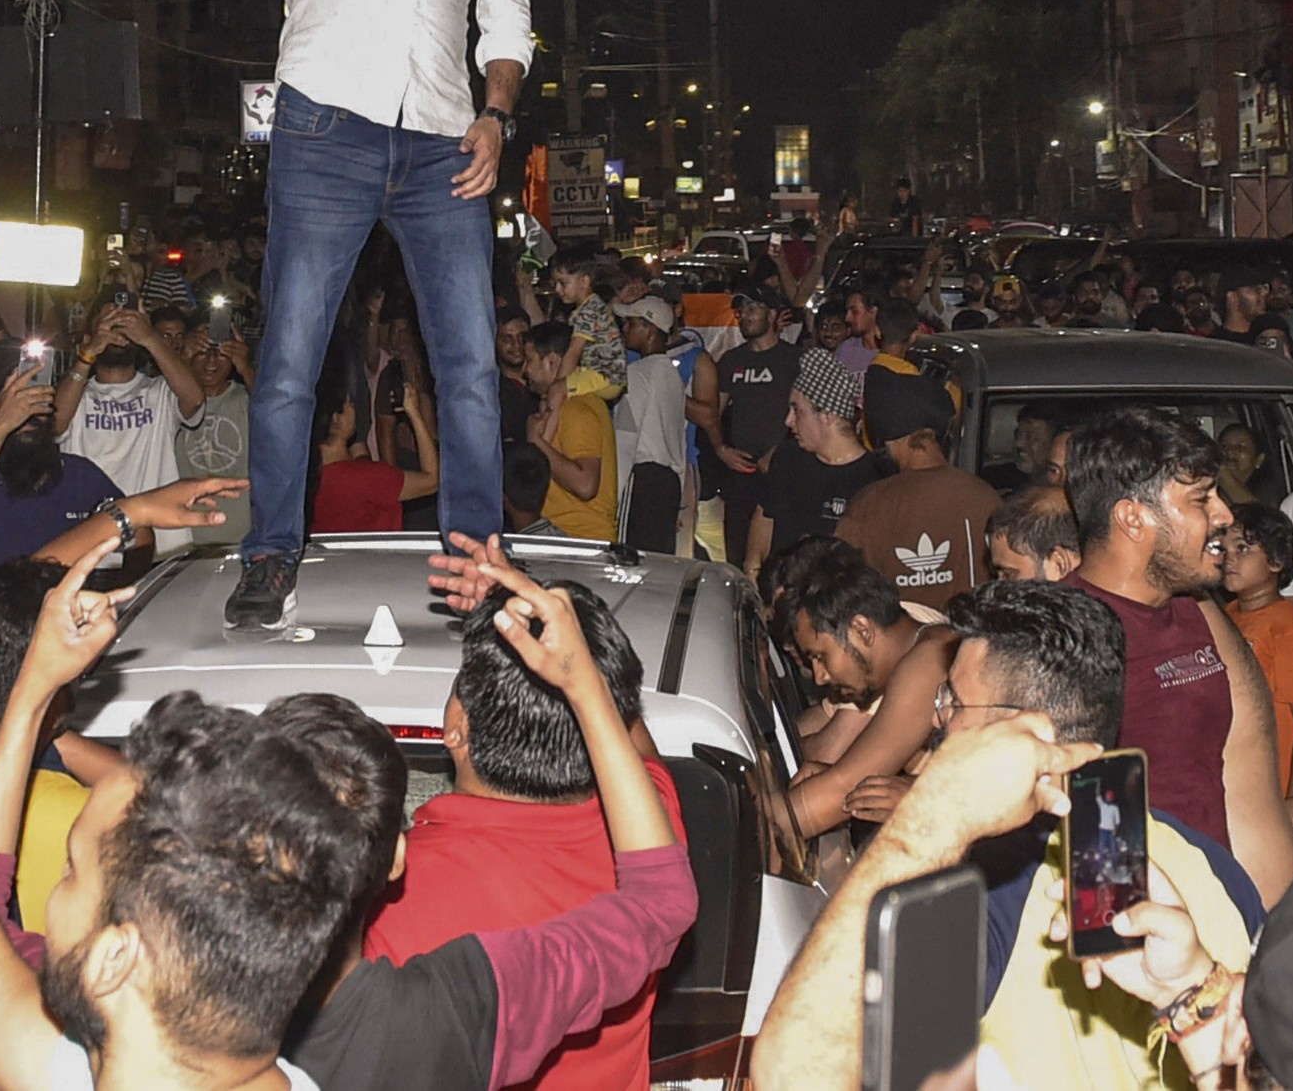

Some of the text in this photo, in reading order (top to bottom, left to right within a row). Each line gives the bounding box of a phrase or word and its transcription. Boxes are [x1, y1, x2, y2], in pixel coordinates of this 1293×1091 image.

[553, 185, 600, 202] CCTV
[731, 366, 773, 384] FILA
[93, 395, 144, 414] STREET
[85, 408, 153, 431] FIGHTER
[895, 570, 953, 587] adidas
